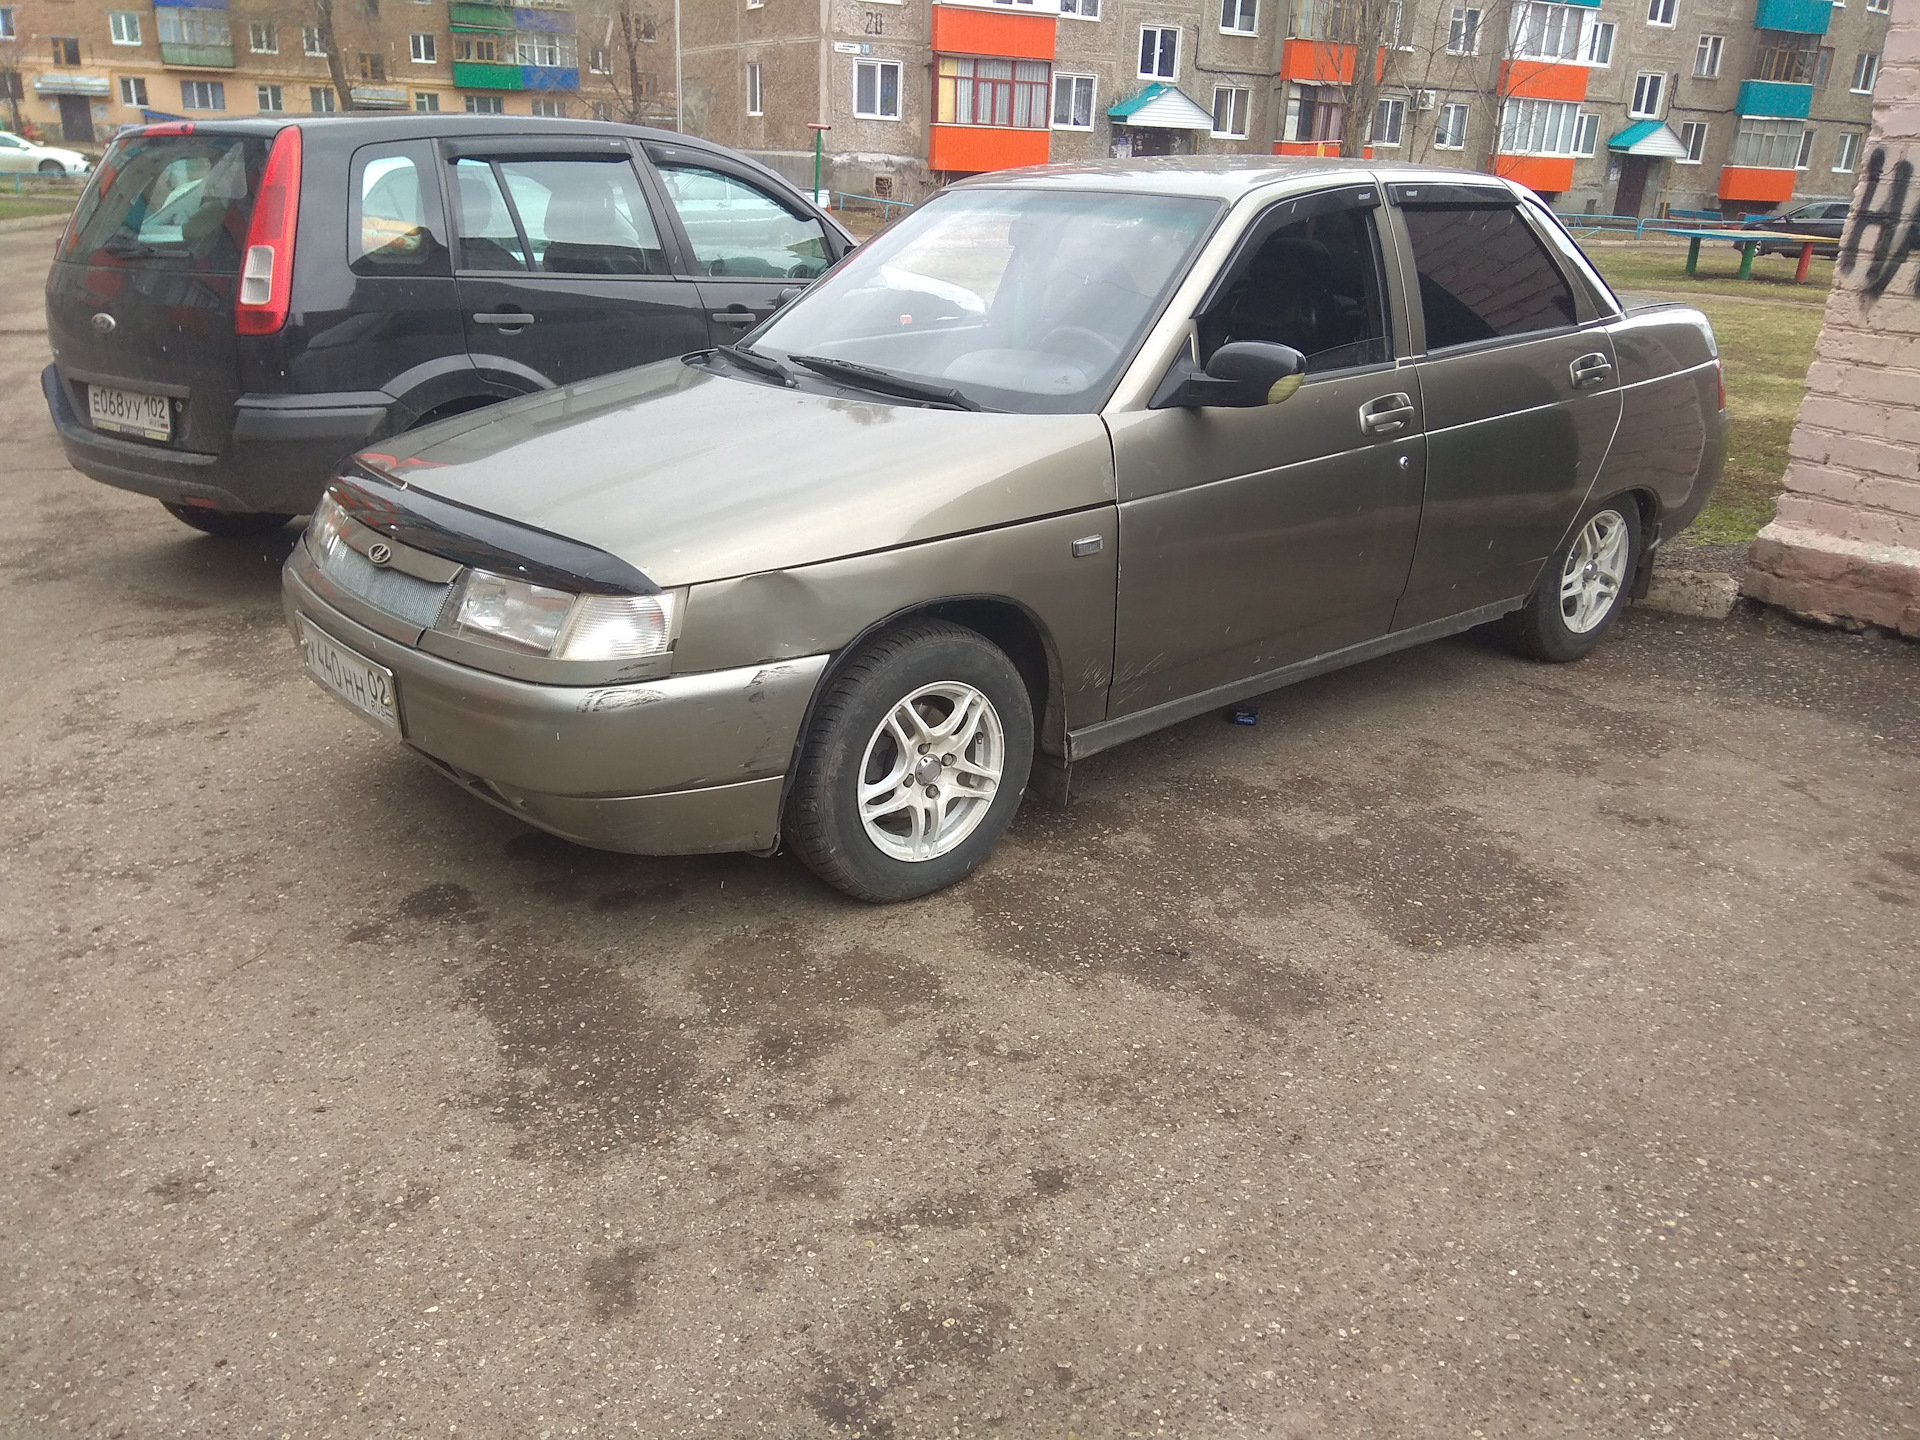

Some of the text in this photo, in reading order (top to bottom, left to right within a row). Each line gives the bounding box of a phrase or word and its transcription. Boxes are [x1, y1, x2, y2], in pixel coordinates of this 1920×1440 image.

[862, 44, 870, 54] 20
[93, 389, 165, 420] Е068УУ 102
[368, 669, 389, 706] 02
[371, 700, 386, 717] RUS
